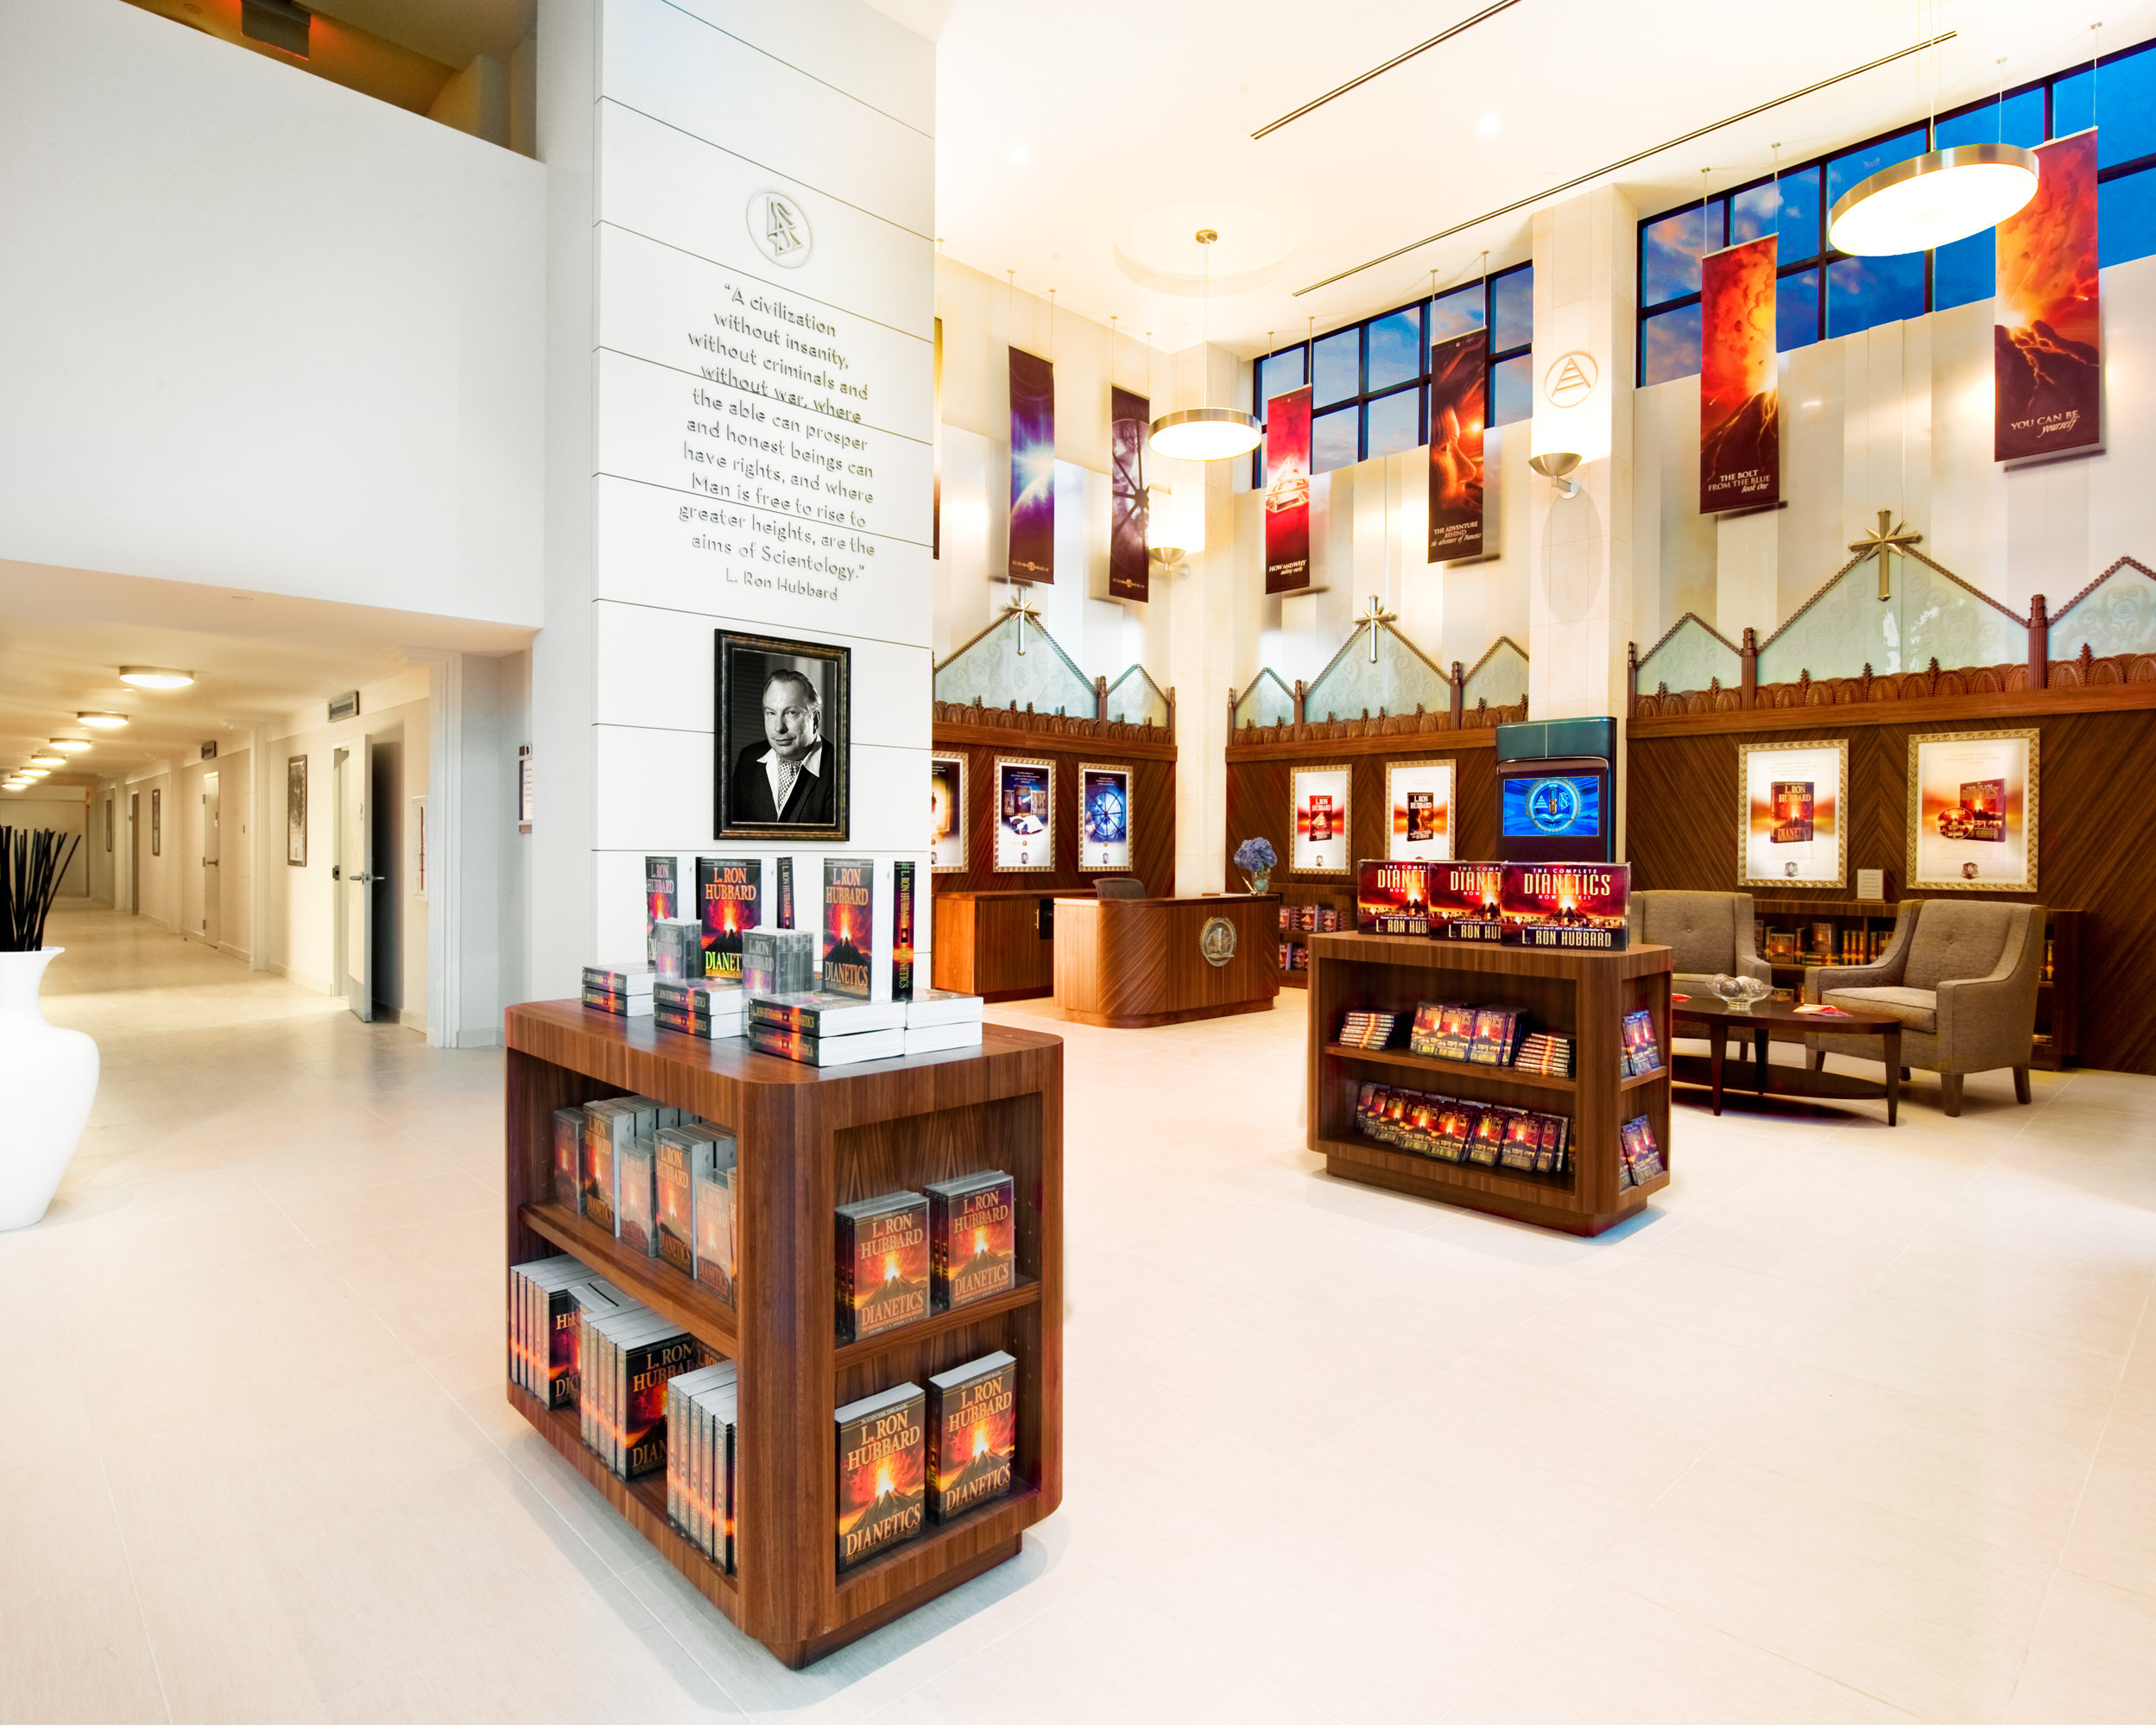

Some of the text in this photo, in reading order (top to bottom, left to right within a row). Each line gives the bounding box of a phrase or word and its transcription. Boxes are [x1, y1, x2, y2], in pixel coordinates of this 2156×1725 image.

[750, 296, 836, 337] civilization
[714, 313, 849, 370] without insanity,
[688, 332, 868, 401] without criminals and
[701, 365, 862, 423] without war, where
[692, 389, 868, 451] the able can prosper
[2011, 409, 2078, 430] YOU CAN BE
[2037, 415, 2080, 439] yourself
[687, 420, 873, 477] and honest beings can
[684, 440, 874, 503] have rights, and where
[1708, 475, 1770, 491] FROM THE BLUE
[1720, 470, 1758, 482] THE BOLT
[692, 472, 866, 528] Man is free to rise to
[679, 504, 876, 555] greater heights, are the
[1445, 521, 1478, 533] ADVENTURE
[1445, 529, 1467, 539] BEHIND
[692, 534, 864, 581] aims of Scientology."
[1269, 564, 1283, 572] HOW
[726, 567, 838, 601] L. Ron Hubbard
[1779, 793, 1811, 803] HUBBARD
[651, 864, 669, 878] L. RON
[713, 867, 748, 883] L. RON
[832, 868, 862, 886] L. RON
[1377, 869, 1426, 888] DIANET
[1451, 871, 1501, 891] DIANET
[648, 879, 673, 894] HUBBARD
[705, 884, 756, 900] HUBBARD
[901, 877, 909, 891] RON
[1524, 874, 1611, 895] DIANETICS
[825, 887, 869, 906] HUBBARD
[1375, 919, 1384, 932] L.
[1388, 919, 1406, 933] RON
[1448, 924, 1457, 938] L.
[1461, 925, 1480, 938] RON
[1521, 930, 1611, 947] L. RON HUBBARD
[705, 951, 743, 971] DIANET
[825, 961, 869, 988] DIANETICS
[661, 1144, 683, 1168] L. RON
[656, 1159, 689, 1189] HUBBARD
[963, 1199, 975, 1214] L.
[975, 1191, 1000, 1210] RON
[871, 1222, 883, 1239] L.
[885, 1213, 913, 1235] RON
[954, 1204, 1008, 1234] HUBBARD
[861, 1229, 923, 1259] HUBBARD
[954, 1262, 1008, 1296] DIANETICS
[861, 1290, 924, 1326] DIANETICS
[647, 1353, 660, 1370] L.
[961, 1391, 973, 1409] L.
[974, 1376, 1002, 1404] RON
[948, 1391, 1012, 1432] HUBBARD
[861, 1425, 874, 1445] L.
[876, 1409, 908, 1439] RON
[847, 1425, 920, 1471] HUBBARD
[946, 1463, 1010, 1511] DIANETICS
[846, 1502, 920, 1558] DIANETICS
